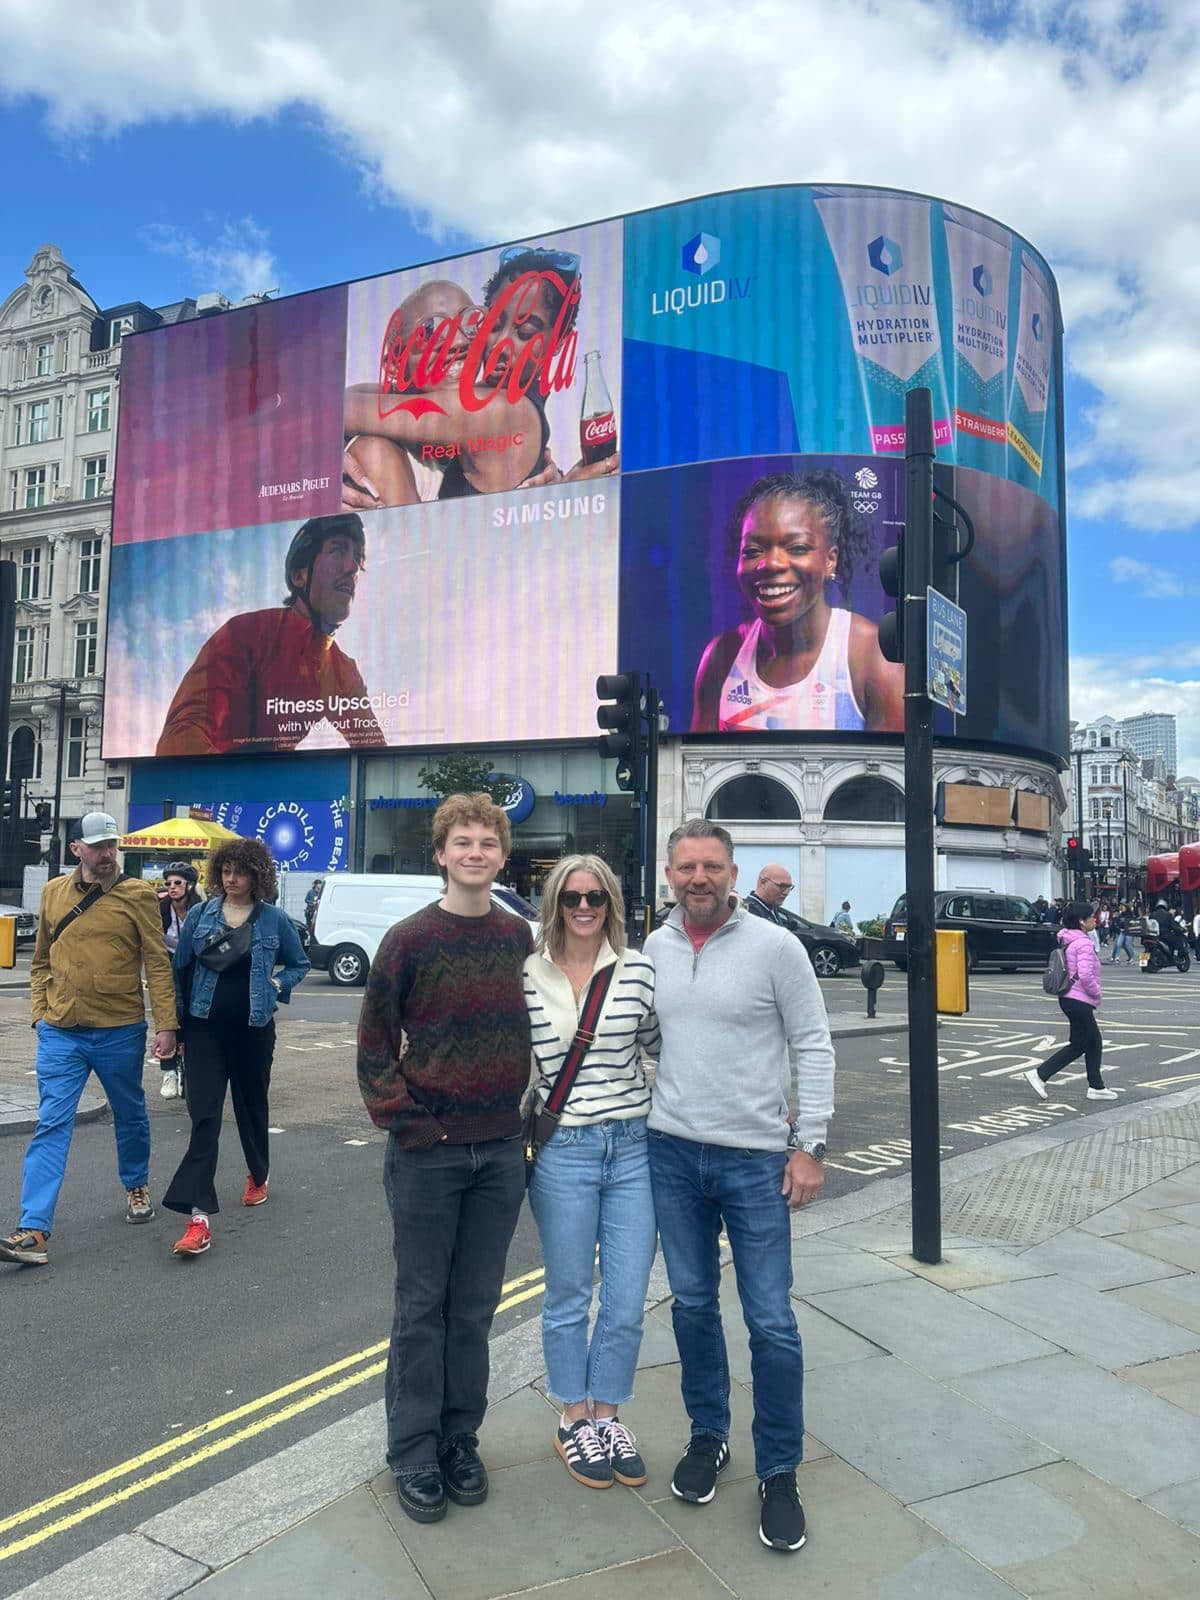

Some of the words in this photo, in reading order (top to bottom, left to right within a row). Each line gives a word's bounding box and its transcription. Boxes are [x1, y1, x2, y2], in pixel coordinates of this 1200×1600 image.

[652, 279, 726, 315] LIQUID
[857, 318, 930, 332] HYDRATION
[957, 323, 1004, 347] HYDRATION
[858, 331, 934, 345] MULTIPLIER
[957, 334, 1004, 358] MULTIPLIER
[421, 441, 462, 461] Real
[467, 431, 525, 454] Magic
[258, 482, 301, 498] AUDEMARS
[302, 477, 330, 491] PIGUET
[851, 491, 870, 499] TEAM
[871, 491, 882, 500] GB
[493, 494, 606, 528] SAMSUNG
[932, 597, 946, 619] BUS
[266, 697, 324, 715] Fitness
[328, 691, 409, 716] Upscaled
[728, 694, 752, 706] adidas
[278, 719, 302, 733] with
[304, 718, 350, 732] Workout
[353, 716, 395, 729] Tracker
[553, 790, 608, 809] beauty
[330, 800, 343, 829] THE
[122, 837, 147, 846] HOT
[150, 837, 176, 846] DOG
[178, 838, 209, 847] SPOT
[944, 1105, 1065, 1136] RIGHT
